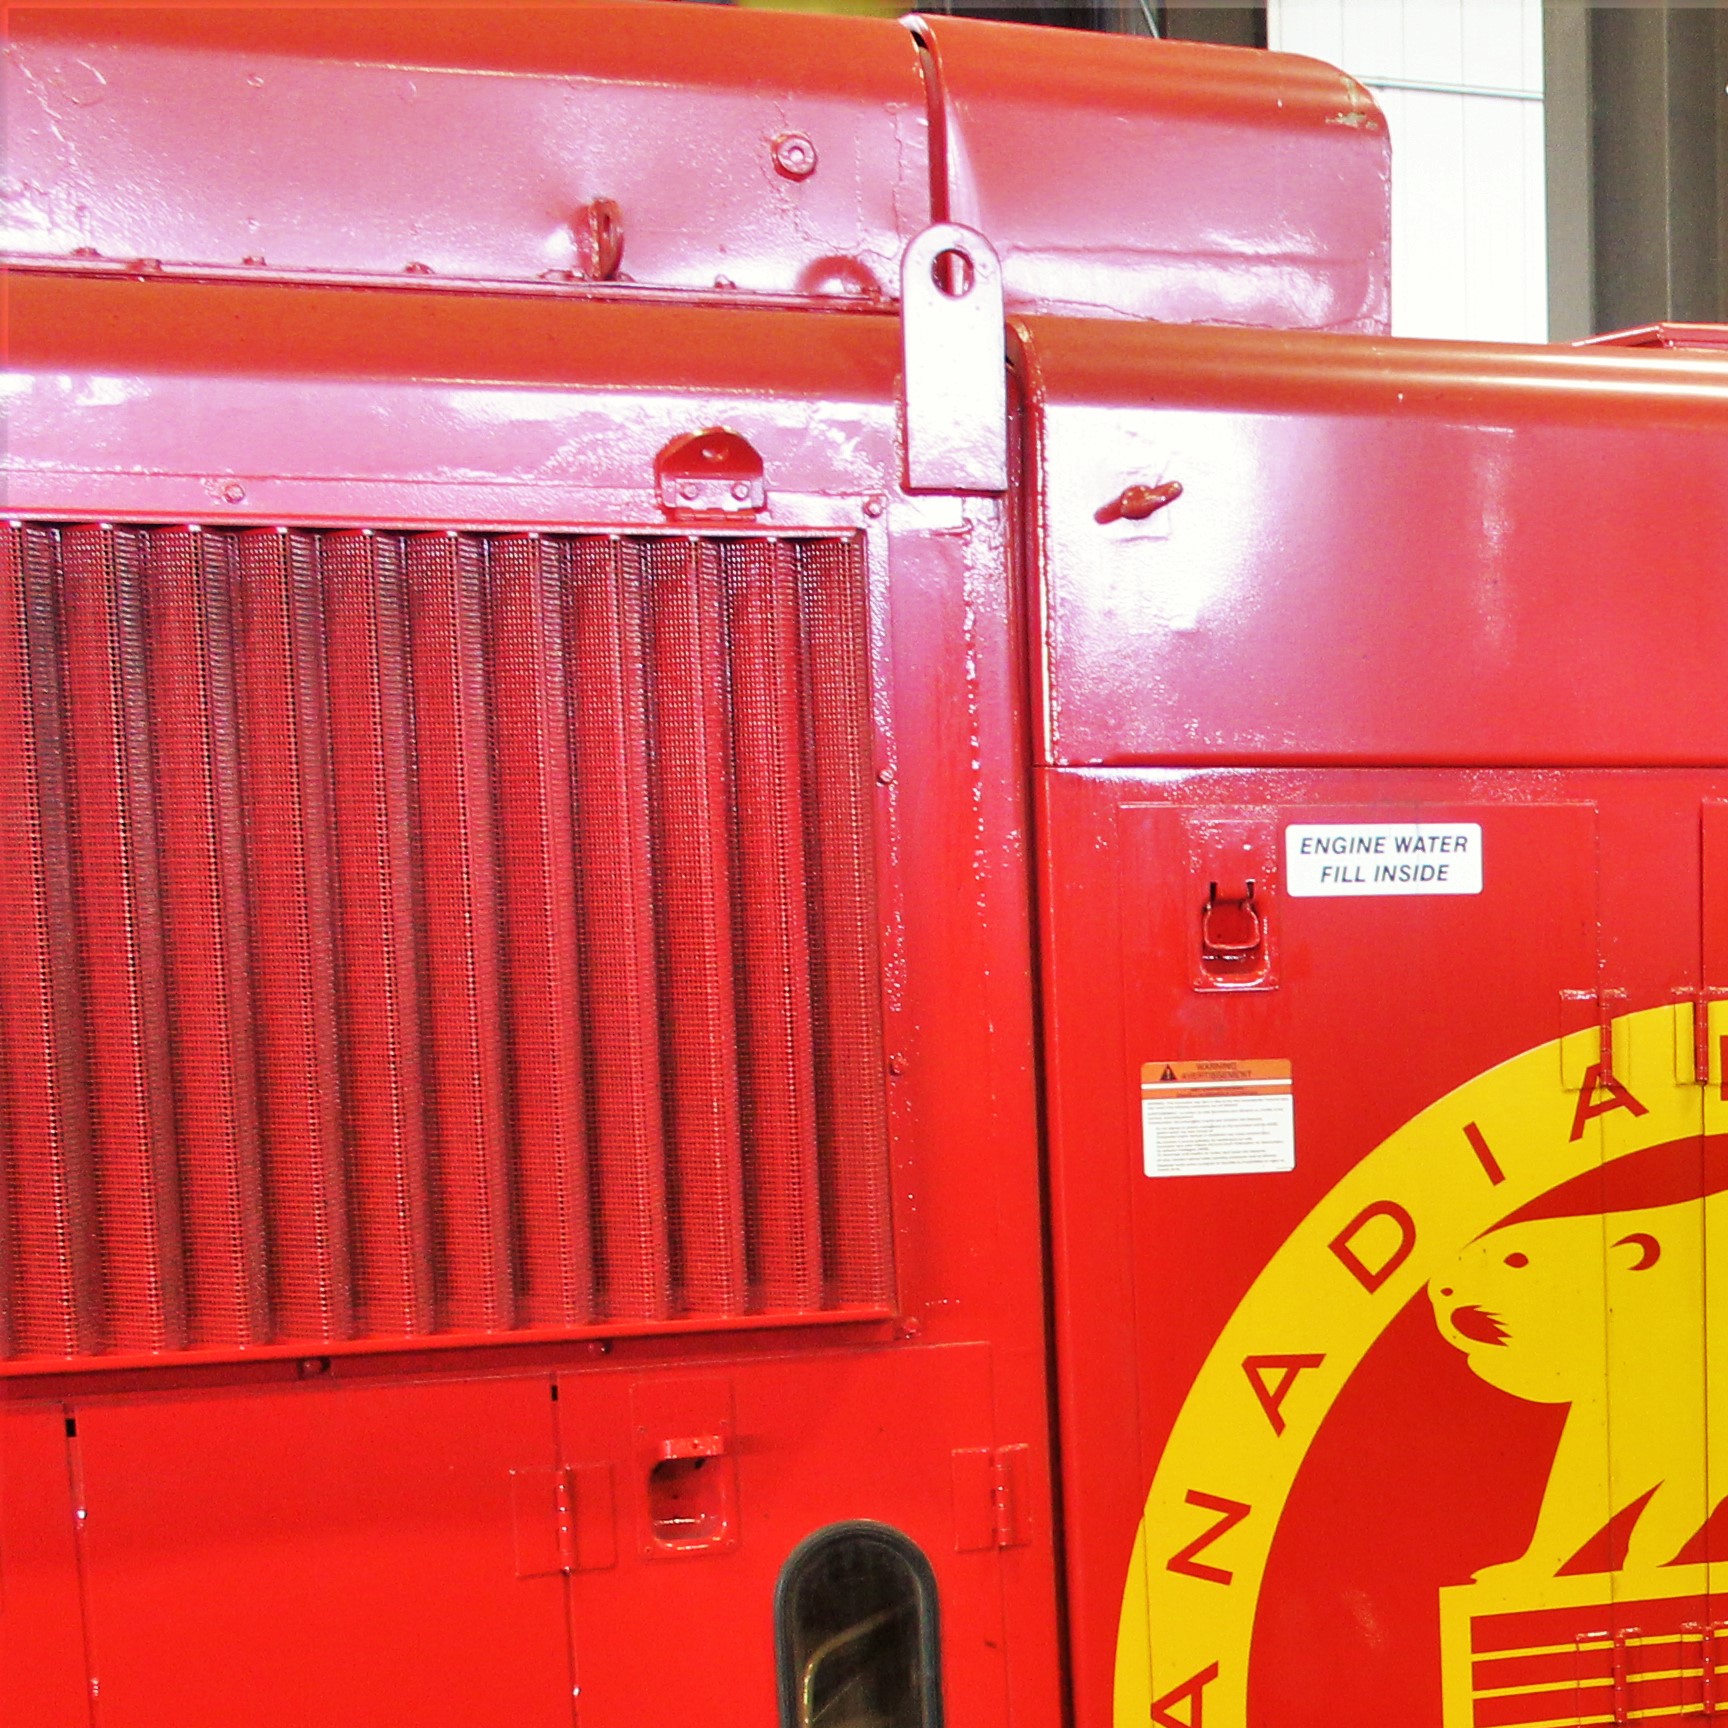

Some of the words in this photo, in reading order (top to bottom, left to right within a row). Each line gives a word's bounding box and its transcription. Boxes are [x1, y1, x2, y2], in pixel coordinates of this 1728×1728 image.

[1300, 836, 1386, 855] ENGINE
[1394, 835, 1468, 854] WATER
[1320, 865, 1367, 883] FILL
[1374, 864, 1450, 882] INSIDE
